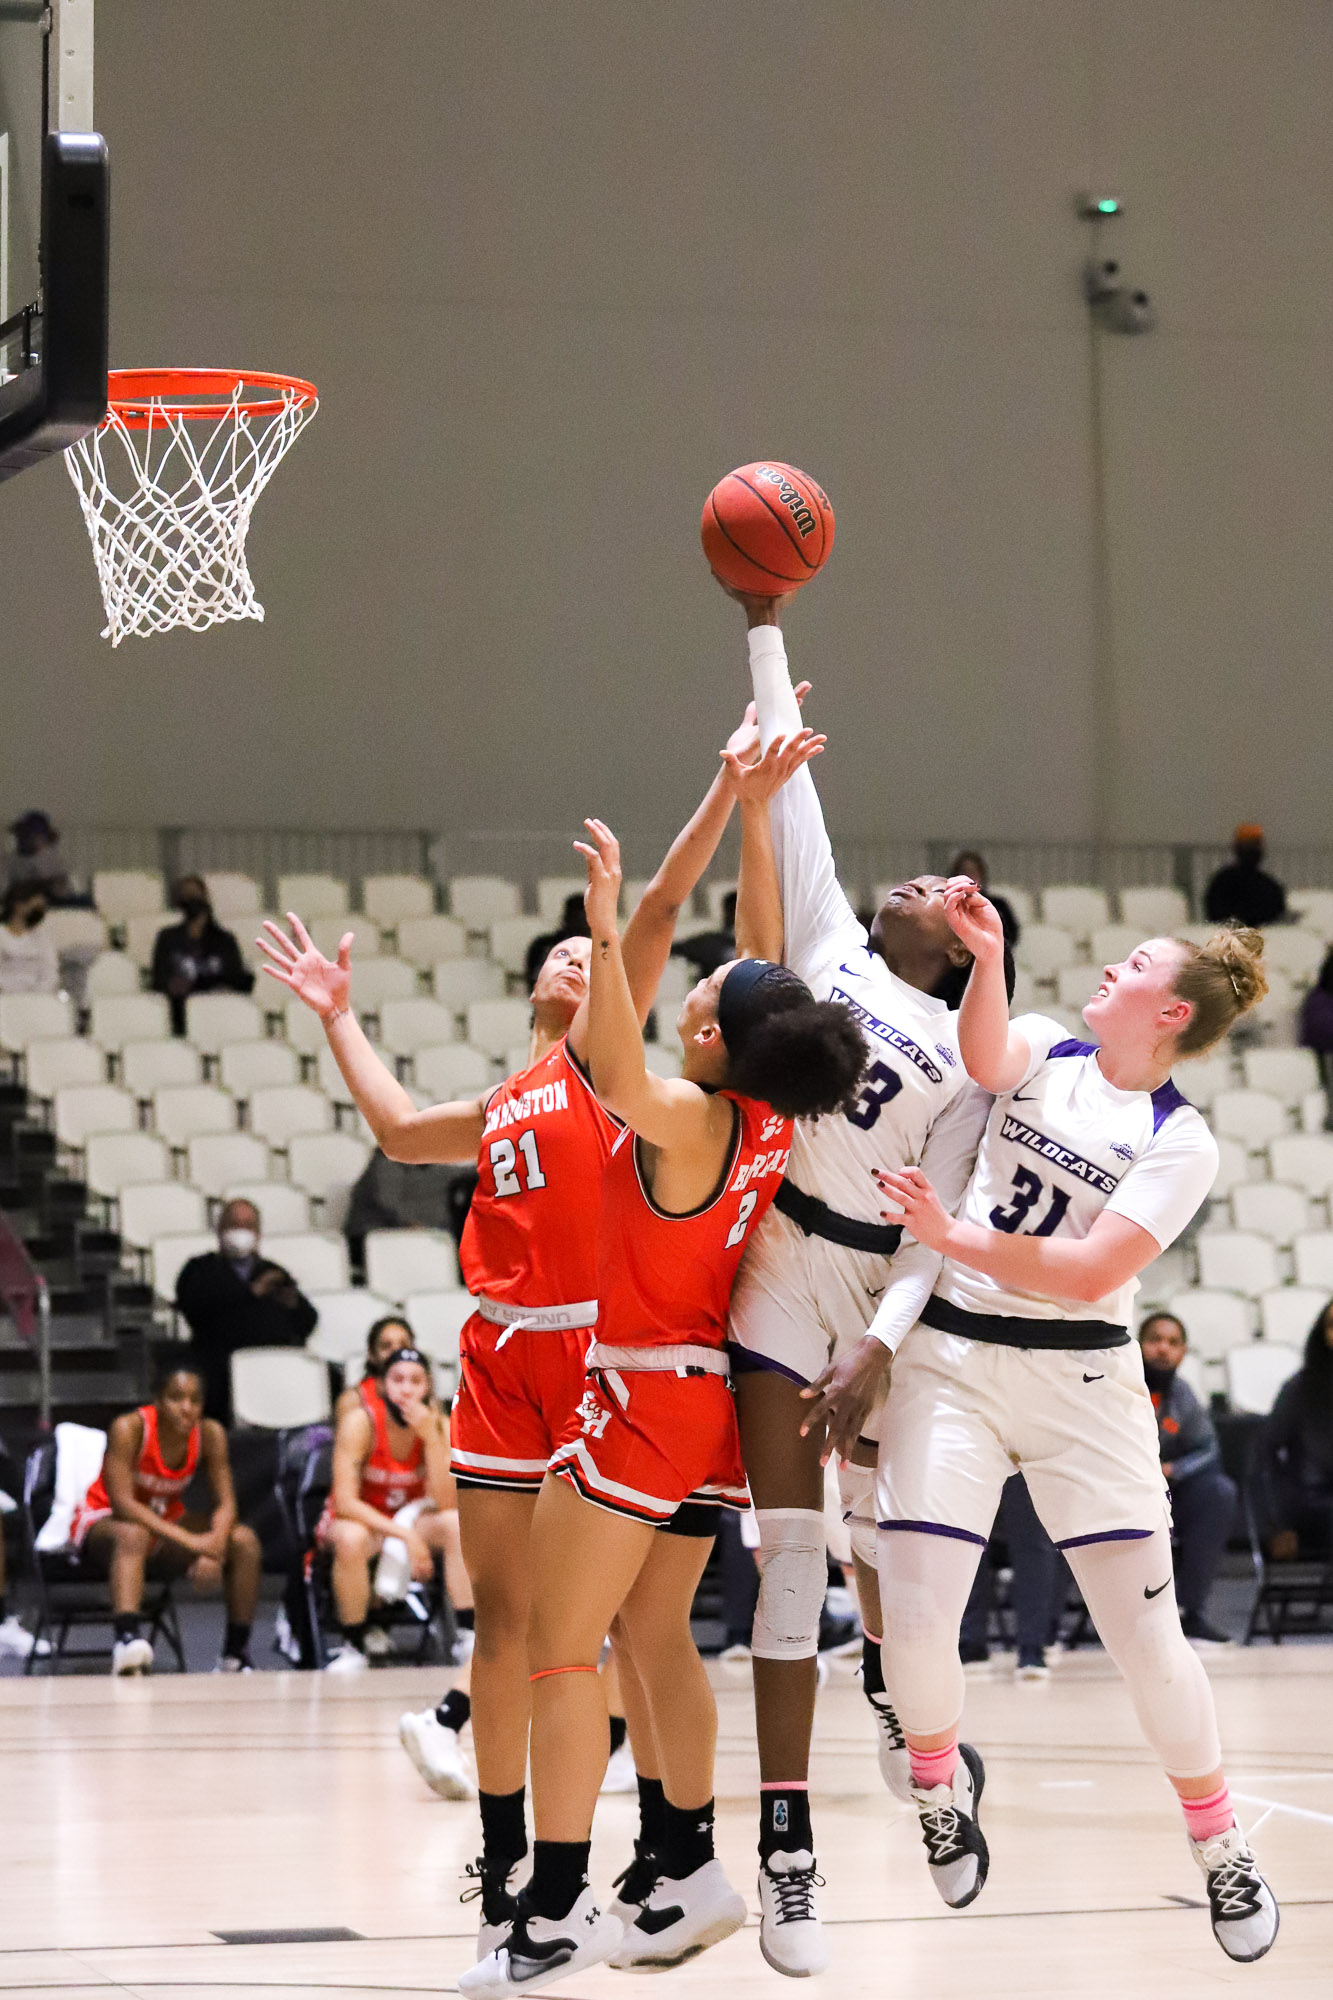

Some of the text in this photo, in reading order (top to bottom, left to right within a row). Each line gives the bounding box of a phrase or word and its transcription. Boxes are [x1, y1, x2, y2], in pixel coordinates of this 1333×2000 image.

[756, 466, 817, 539] Wilson
[489, 1128, 547, 1198] 21
[1001, 1116, 1118, 1194] WILDCATS
[724, 1189, 758, 1250] 2
[989, 1163, 1073, 1237] 31
